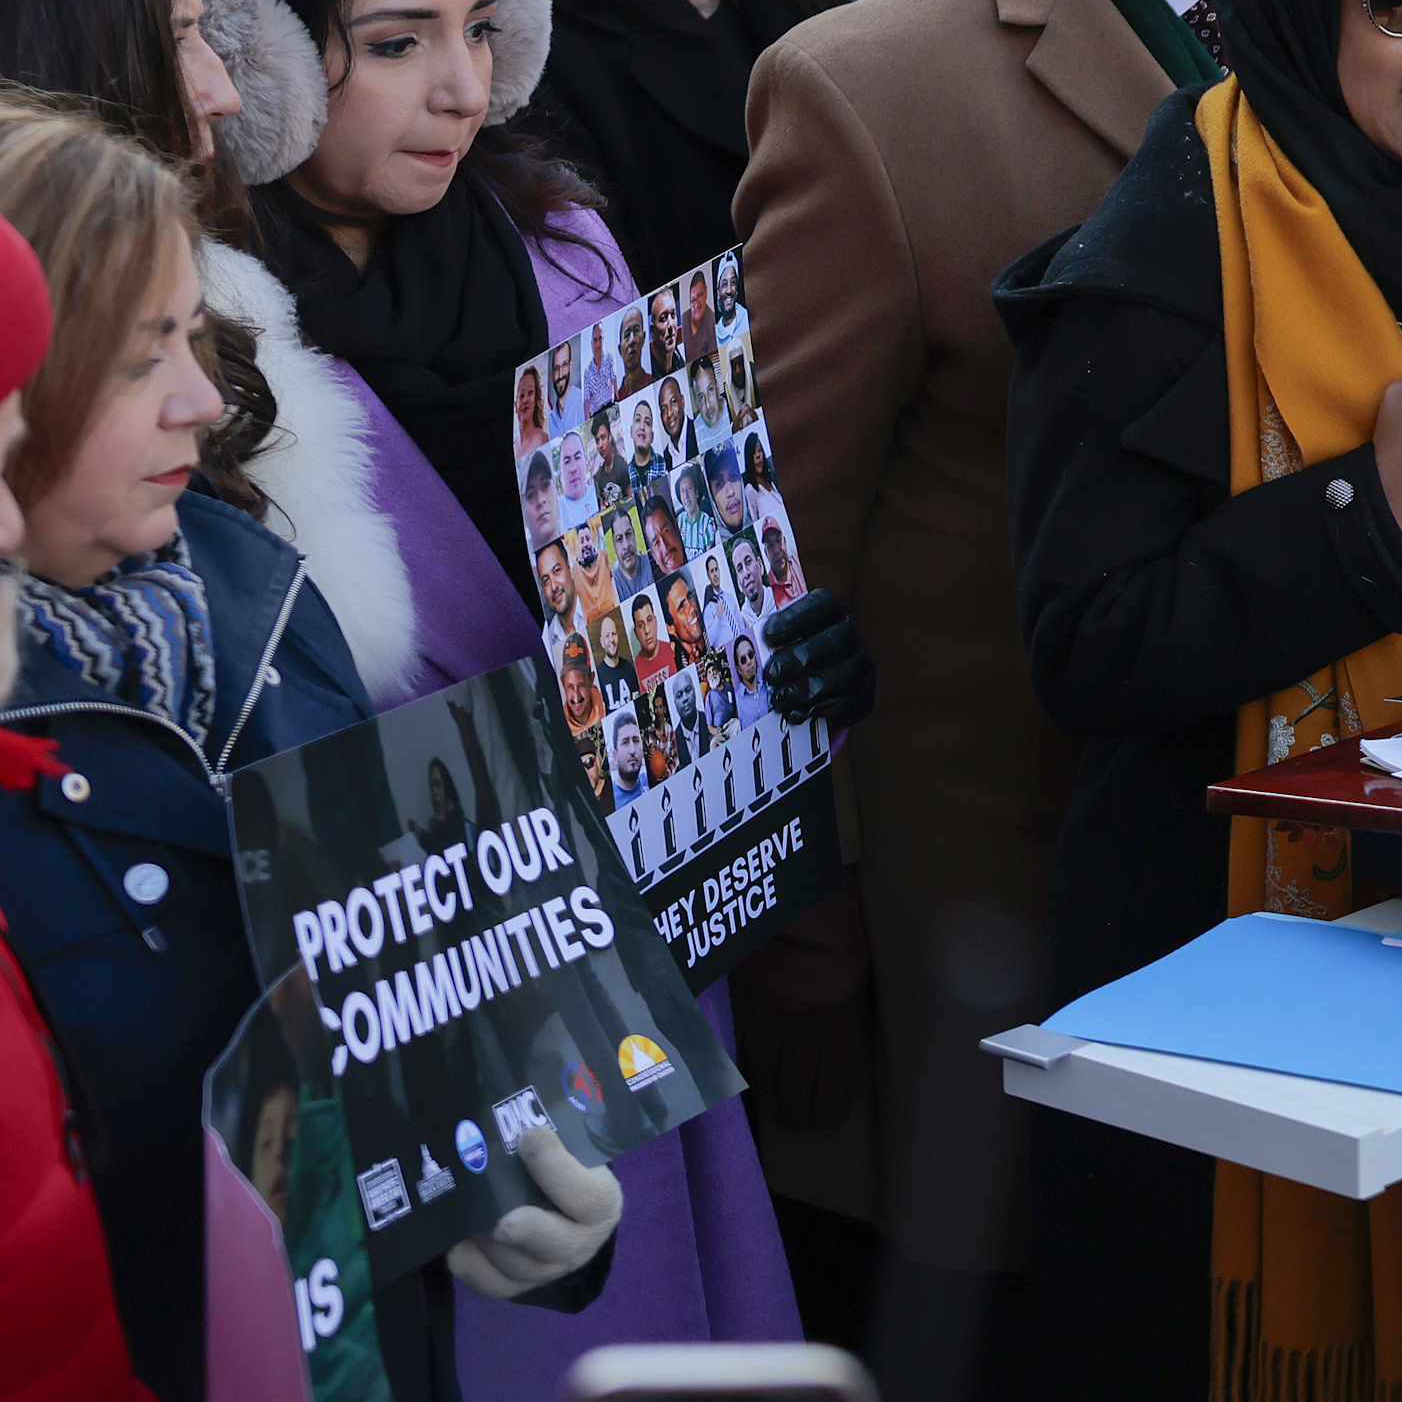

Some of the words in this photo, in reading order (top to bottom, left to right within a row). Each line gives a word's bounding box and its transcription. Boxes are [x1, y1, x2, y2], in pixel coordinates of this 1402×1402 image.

[292, 840, 475, 984] PROTECT
[476, 807, 574, 898] OUR
[653, 889, 697, 946] HEY
[703, 817, 804, 915] DESERVE
[685, 874, 777, 969] JUSTICE
